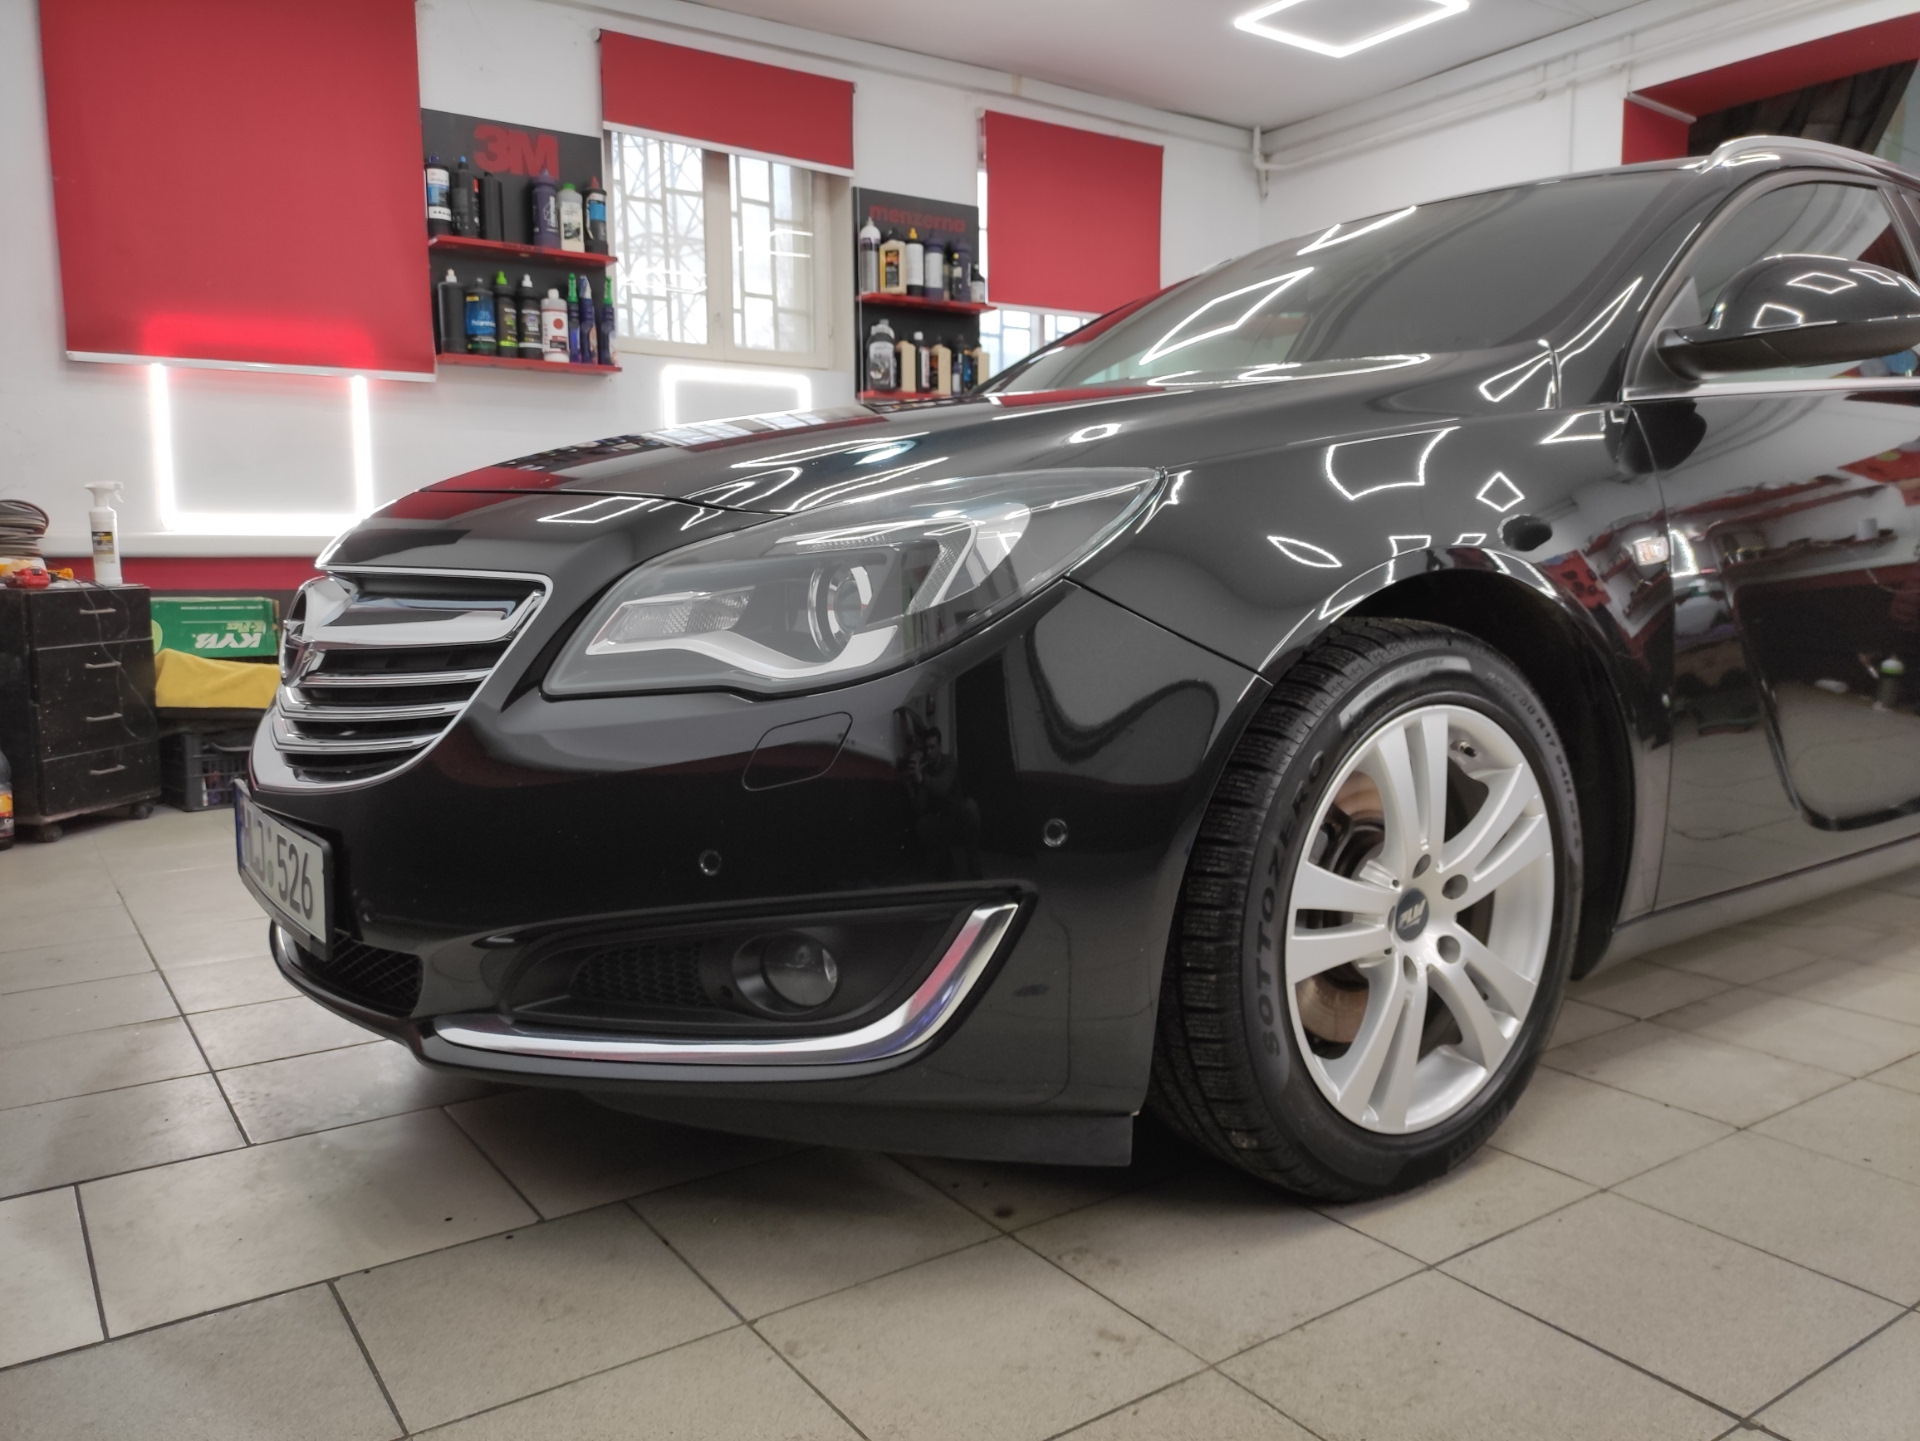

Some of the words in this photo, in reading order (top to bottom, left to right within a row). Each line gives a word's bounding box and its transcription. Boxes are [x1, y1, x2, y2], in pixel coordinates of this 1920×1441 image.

[474, 124, 559, 178] 3M
[195, 633, 262, 649] KYB
[276, 834, 314, 921] 526
